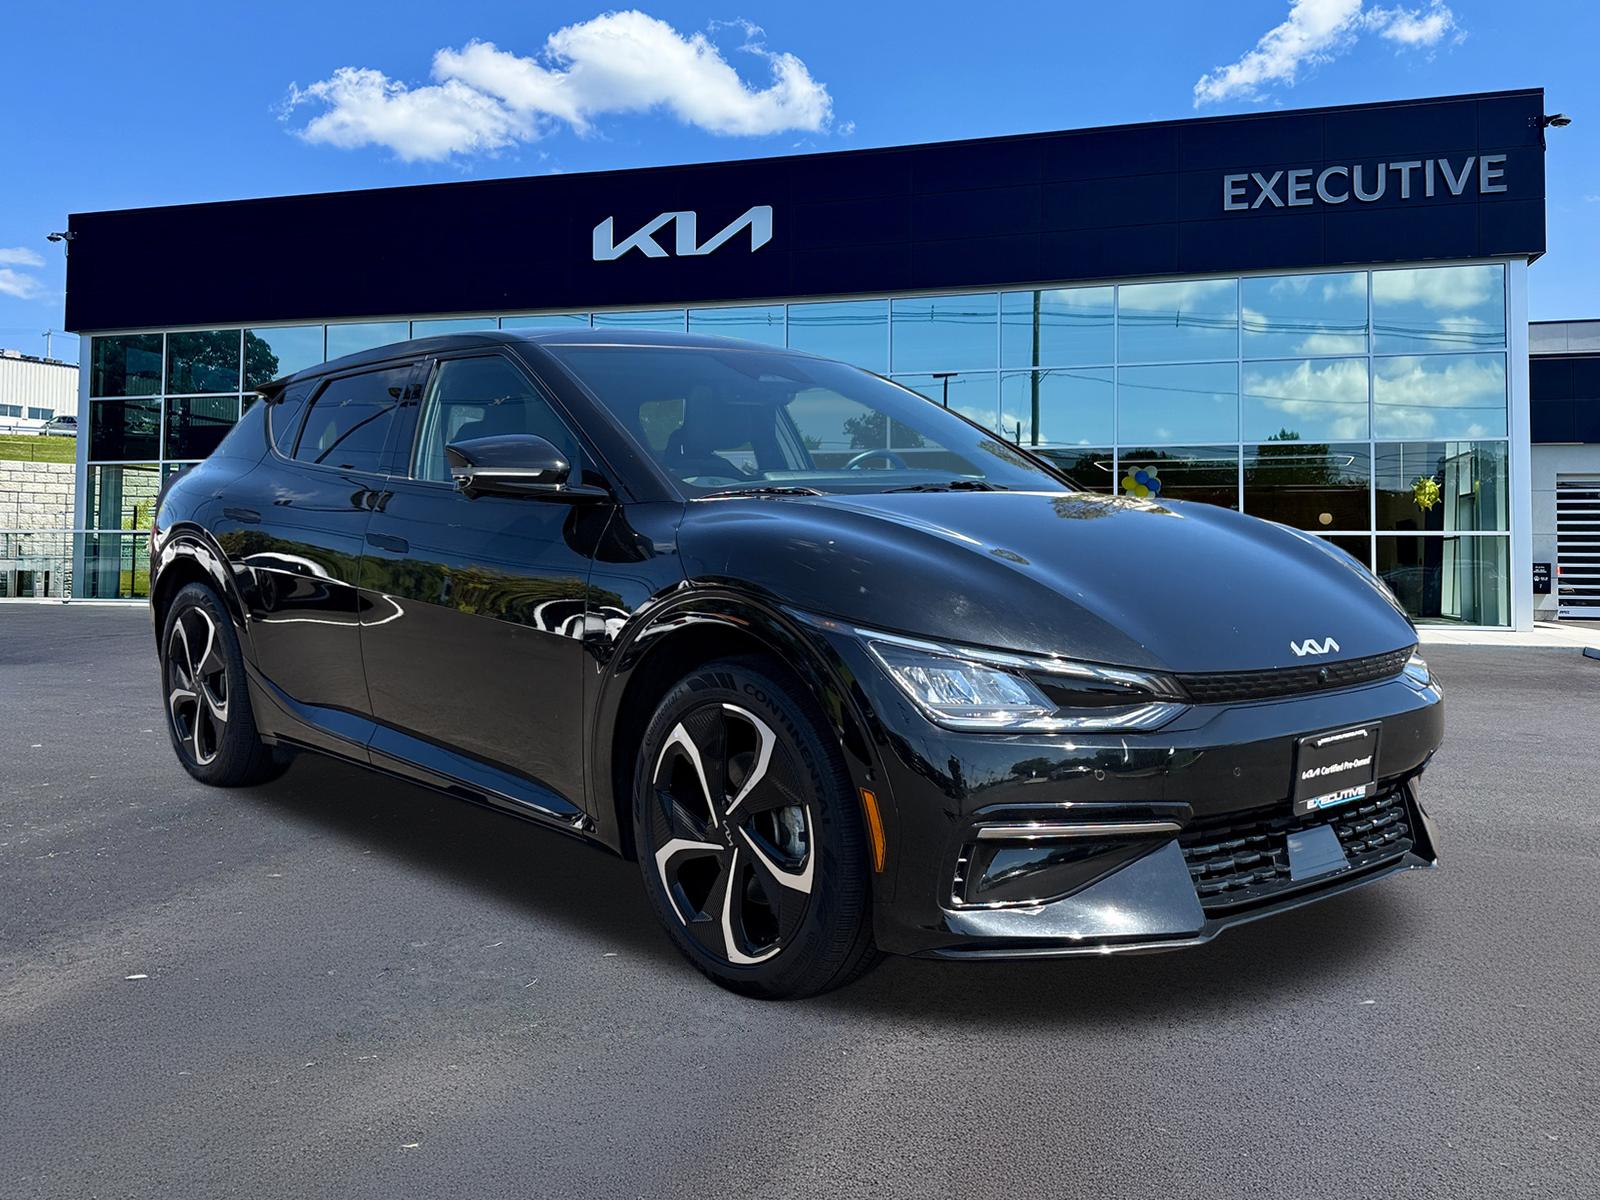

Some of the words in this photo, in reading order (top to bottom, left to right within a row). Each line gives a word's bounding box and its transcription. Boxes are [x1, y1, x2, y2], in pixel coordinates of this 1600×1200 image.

[1224, 154, 1508, 211] EXECUTIVE
[593, 205, 773, 261] KIA
[1290, 637, 1340, 656] KIA
[1307, 785, 1366, 809] EXECUTIVE
